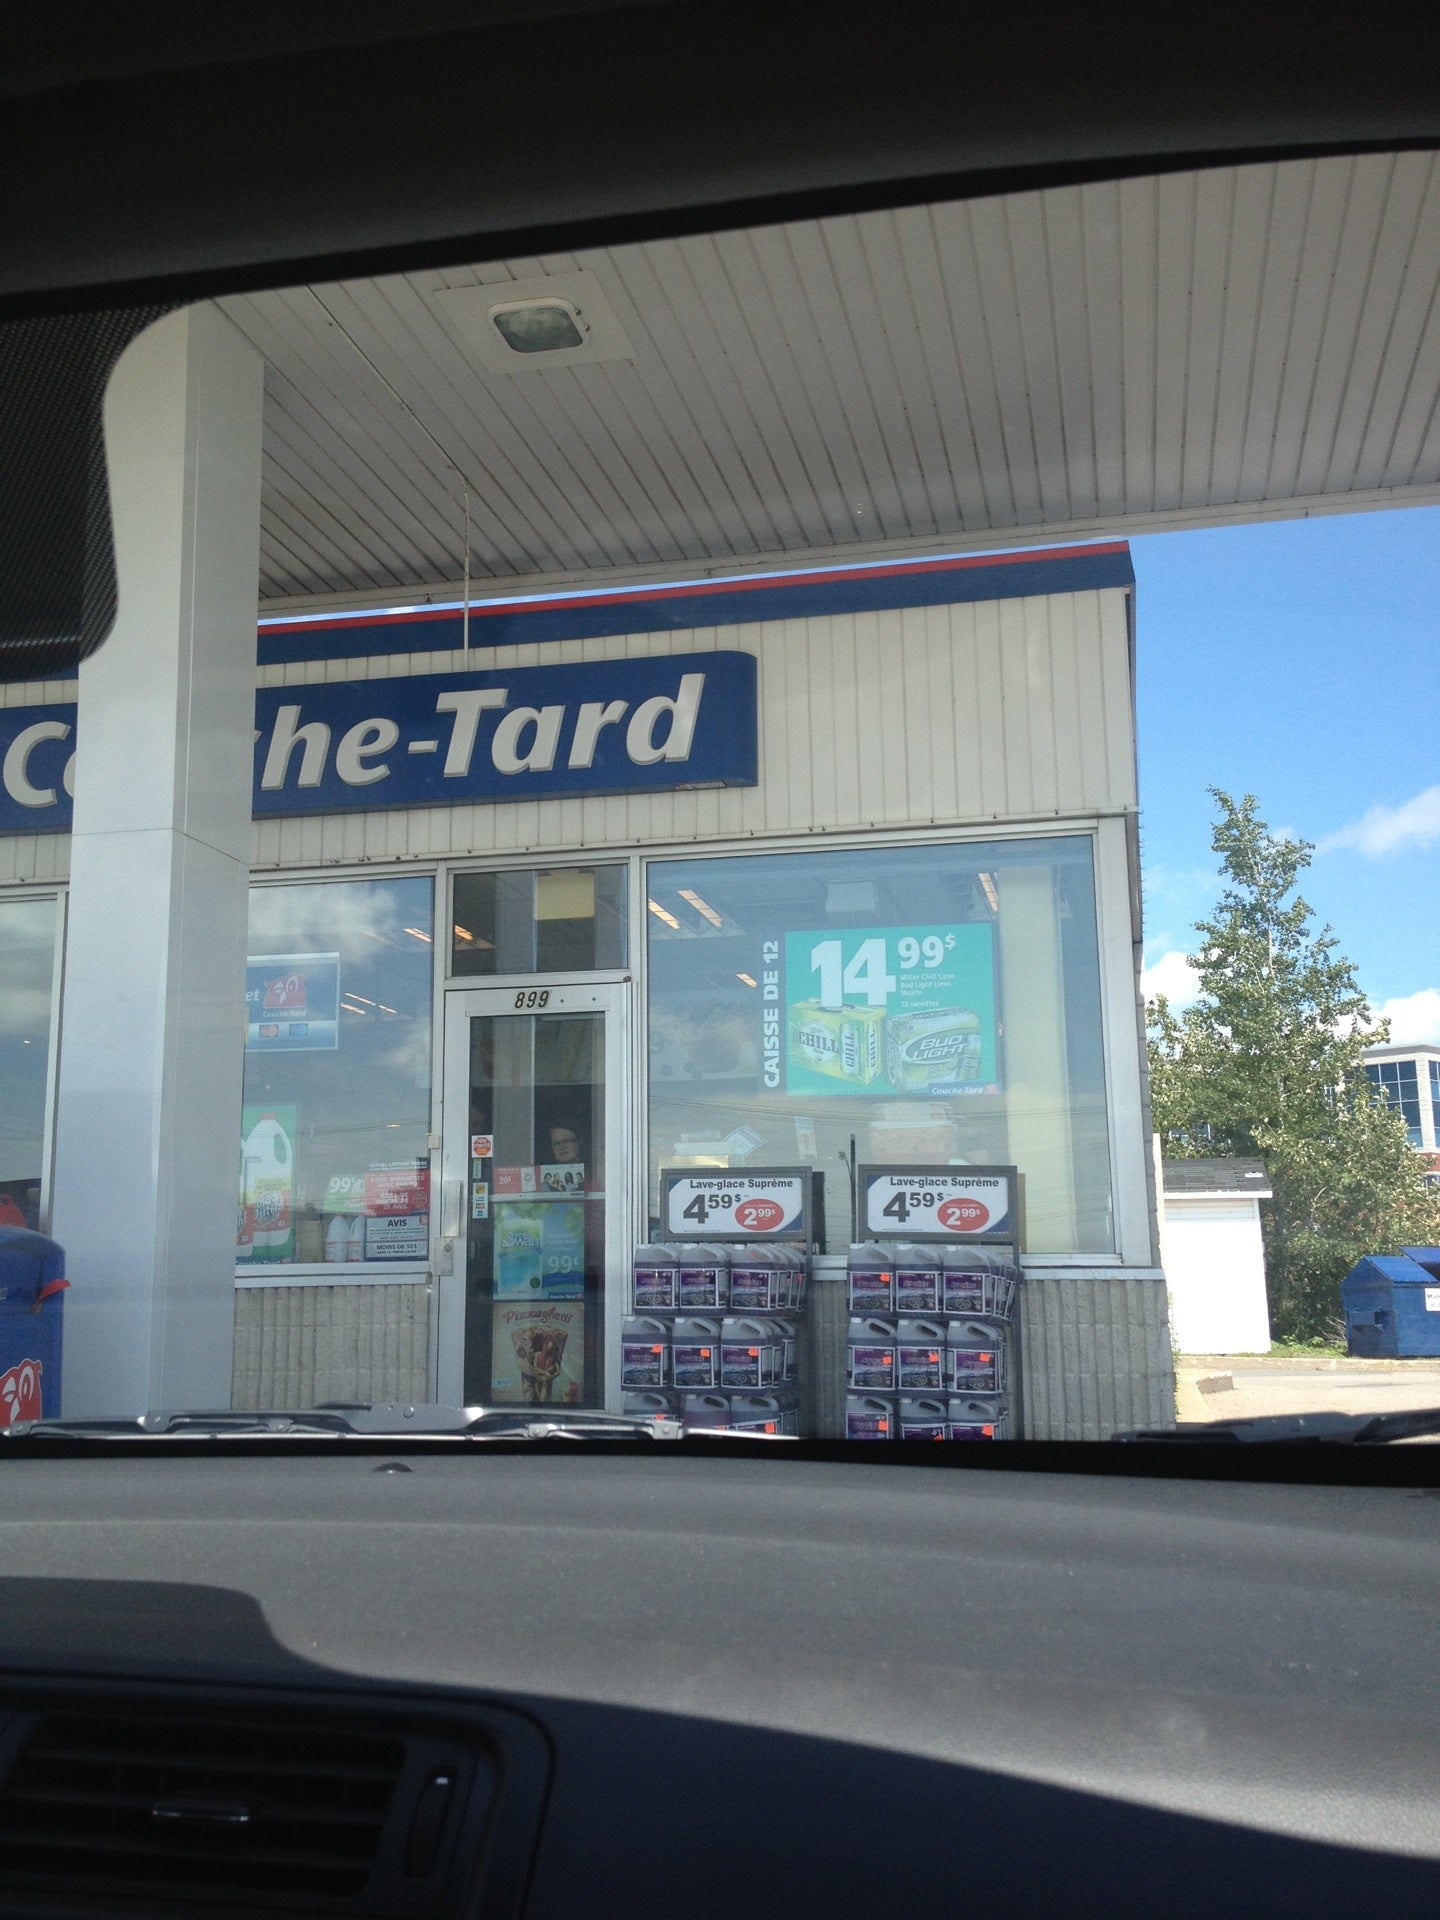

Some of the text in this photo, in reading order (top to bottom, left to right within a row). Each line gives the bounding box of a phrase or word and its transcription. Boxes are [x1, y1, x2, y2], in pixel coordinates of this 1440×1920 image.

[514, 990, 550, 1009] 899
[763, 940, 779, 1088] CAISSE DE 12
[799, 1031, 840, 1054] CHILL
[844, 1033, 856, 1068] CHILL
[920, 1035, 963, 1050] BUD
[912, 1043, 968, 1061] LIGHT
[690, 1178, 793, 1192] Lave-glace Suprême
[890, 1177, 999, 1189] Lave-glace Suprême
[387, 1219, 408, 1228] AVIS
[502, 1231, 540, 1248] Swan
[503, 1306, 574, 1325] Pizzaghetti
